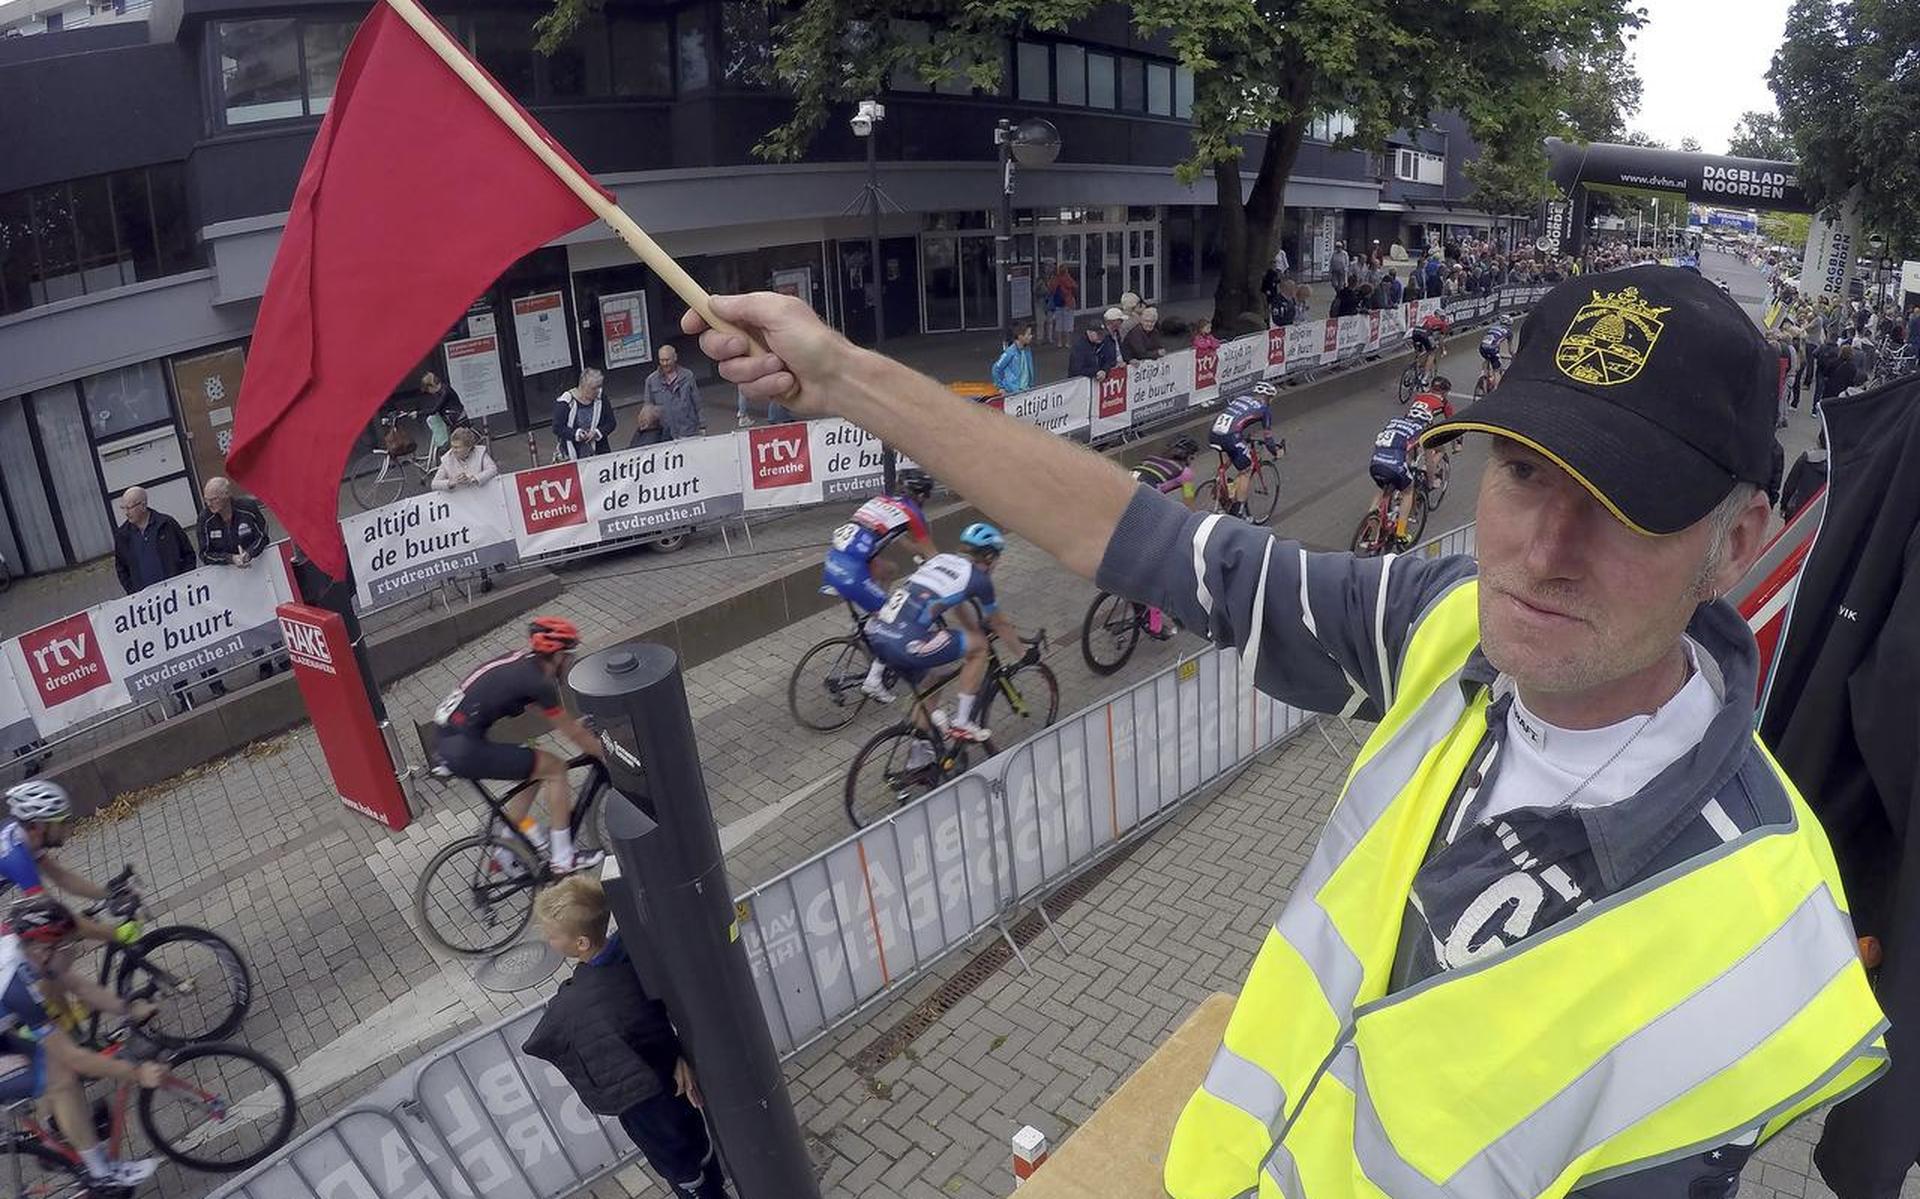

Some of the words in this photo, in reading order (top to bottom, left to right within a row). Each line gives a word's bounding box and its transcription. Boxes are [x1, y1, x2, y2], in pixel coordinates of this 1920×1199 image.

[1620, 174, 1687, 189] www.dvhn.nl
[1702, 179, 1784, 199] NOORDEN
[1703, 165, 1785, 186] DAGBLAD
[1824, 233, 1842, 293] DAGBLAD
[1833, 234, 1851, 294] NOORDEN
[1102, 378, 1125, 398] rtv
[1016, 395, 1048, 418] altijd
[1052, 393, 1063, 409] in
[757, 435, 801, 464] rtv
[828, 453, 851, 473] de
[599, 453, 656, 485] altijd
[664, 450, 684, 470] in
[759, 461, 804, 478] drenthe
[525, 476, 573, 508] rtv
[603, 489, 629, 512] de
[638, 476, 701, 506] buurt
[829, 475, 886, 493] rtvdrent
[364, 504, 420, 543] altijd
[429, 501, 450, 522] in
[531, 503, 577, 522] drenthe
[607, 502, 707, 534] rtvdrenthe.nl
[371, 547, 397, 571] de
[405, 526, 471, 560] buurt
[376, 552, 480, 595] rtvdrenthe.nl
[114, 589, 178, 634] altijd
[187, 583, 211, 608] in
[33, 631, 87, 674] rtv
[125, 640, 155, 666] de
[164, 608, 235, 652] buurt
[283, 621, 330, 661] HAKE
[45, 661, 98, 692] drenthe
[134, 636, 245, 692] rtvdrenthe.nl
